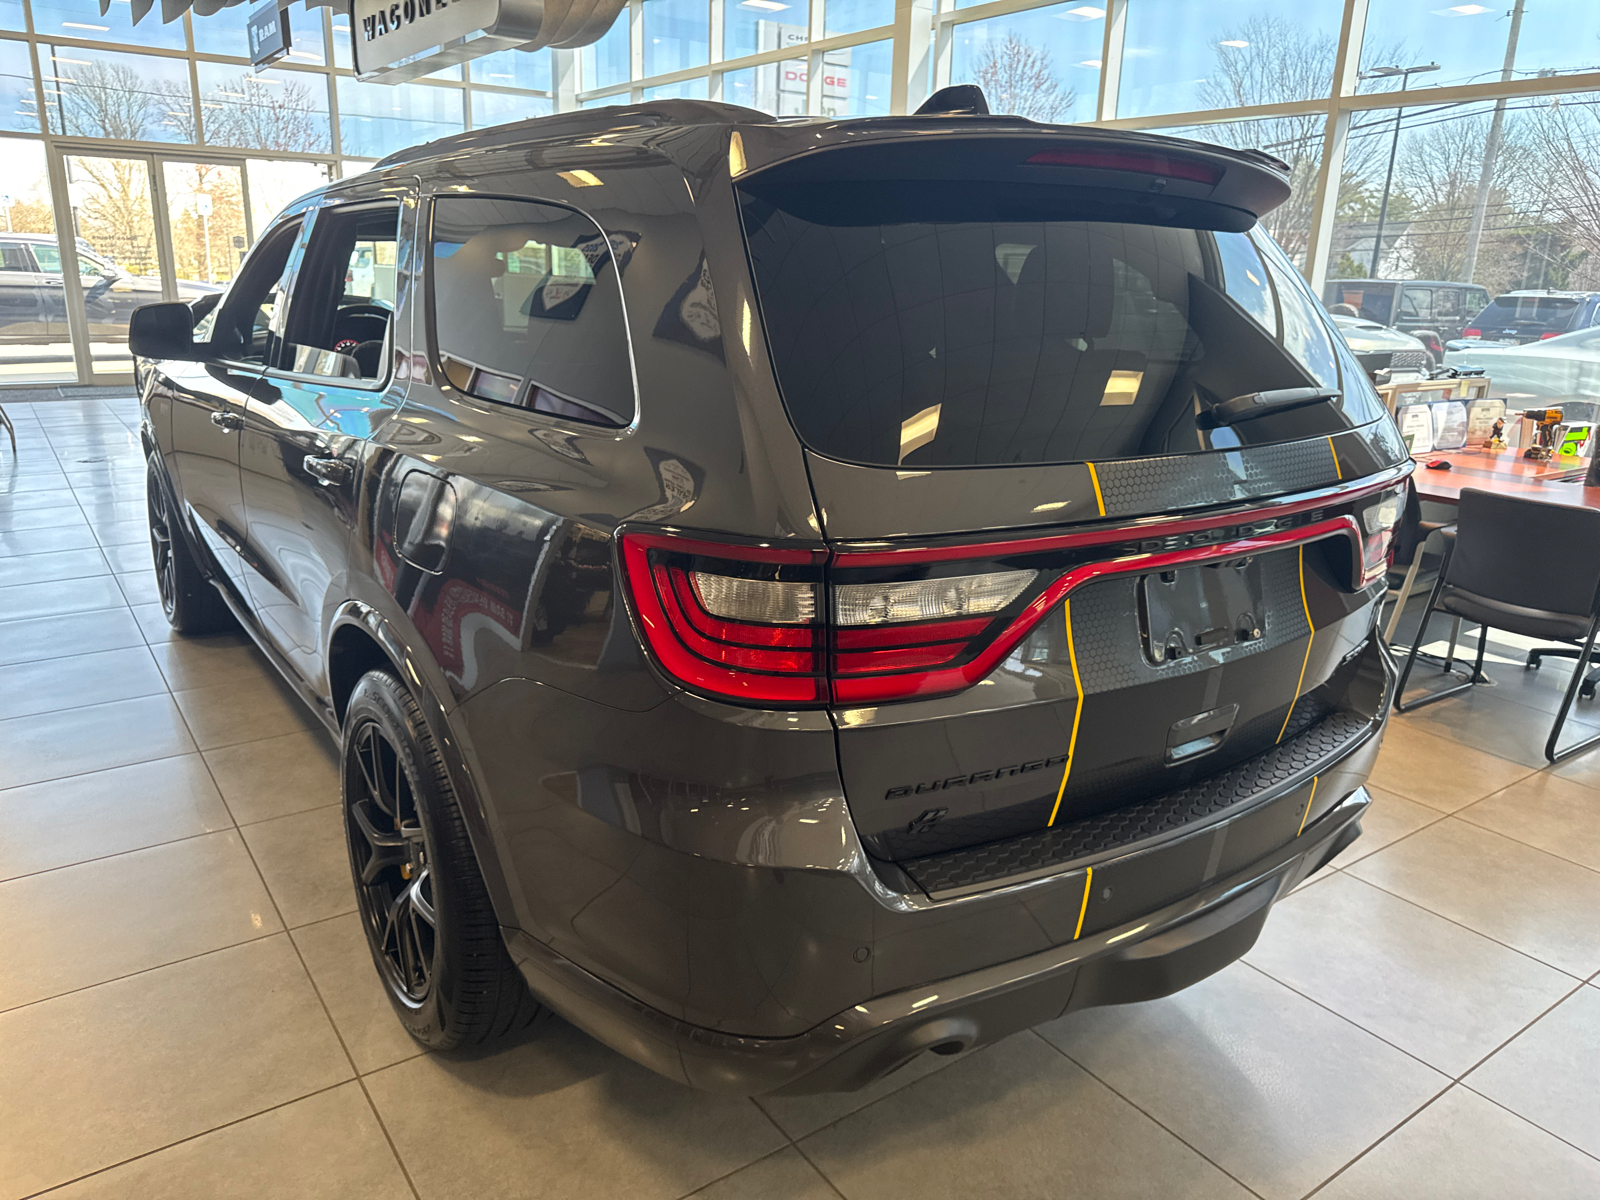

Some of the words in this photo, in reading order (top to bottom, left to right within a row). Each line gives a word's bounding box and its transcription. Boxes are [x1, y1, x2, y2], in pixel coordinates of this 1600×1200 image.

[258, 20, 277, 42] RAM
[362, 0, 460, 41] WAGON
[785, 70, 847, 88] DOGE
[1139, 509, 1325, 553] DODGE
[884, 753, 1070, 801] DURANGO
